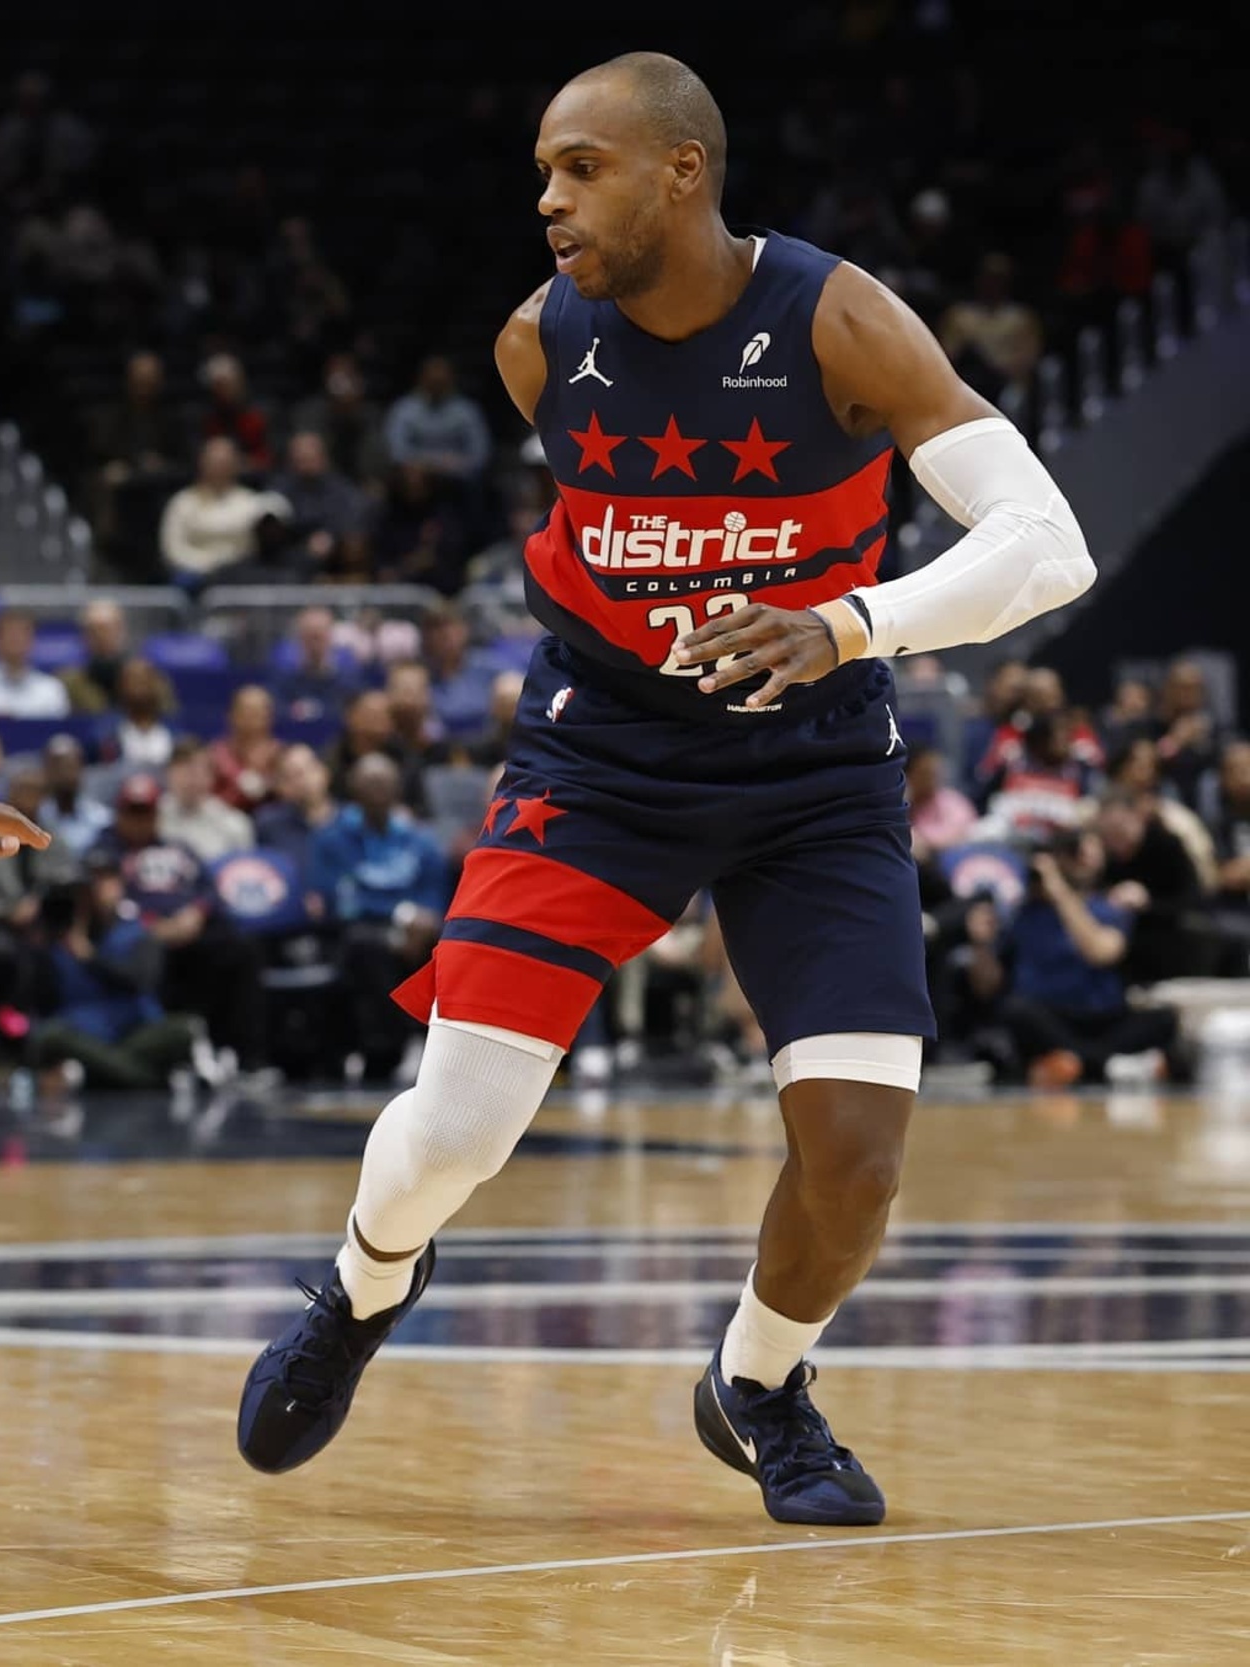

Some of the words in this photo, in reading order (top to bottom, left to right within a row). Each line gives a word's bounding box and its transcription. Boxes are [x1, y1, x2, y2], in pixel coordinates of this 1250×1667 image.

[722, 375, 787, 388] Robinhood
[629, 515, 668, 529] THE
[581, 503, 803, 569] district
[626, 568, 797, 592] COLUMBIA
